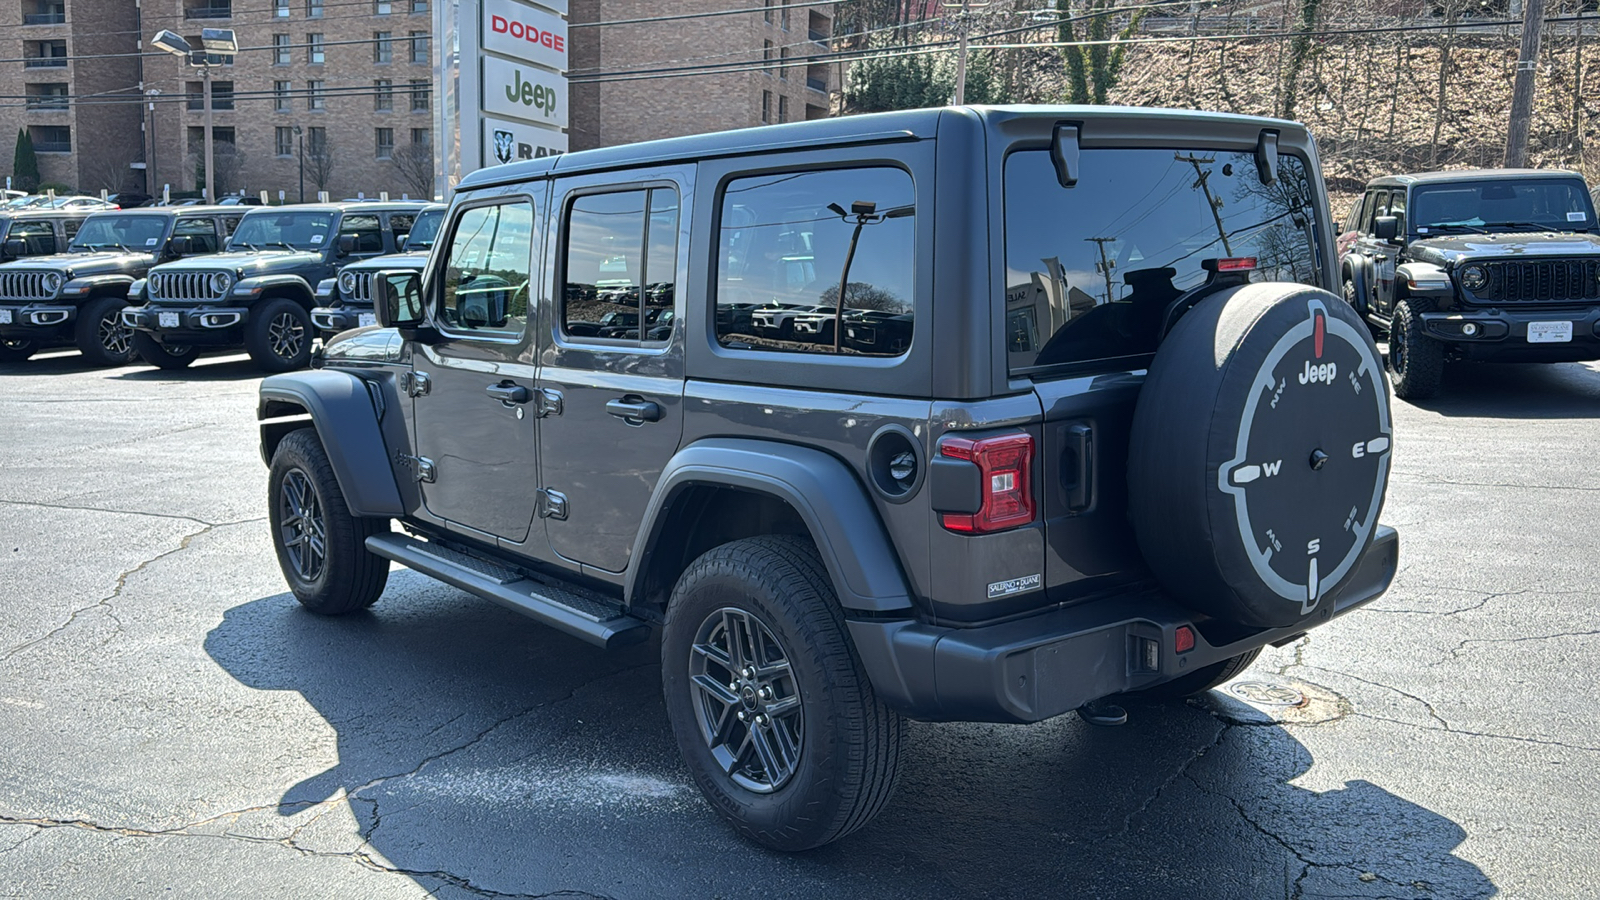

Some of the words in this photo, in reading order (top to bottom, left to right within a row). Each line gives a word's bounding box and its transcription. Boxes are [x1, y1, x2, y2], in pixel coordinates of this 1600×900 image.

[491, 14, 565, 53] DODGE
[505, 69, 556, 117] Jeep
[1298, 360, 1337, 386] Jeep
[1348, 370, 1362, 396] NE
[1269, 376, 1287, 410] NW
[1352, 441, 1365, 459] E
[1262, 458, 1283, 478] W
[1307, 537, 1321, 555] S
[989, 581, 1016, 592] SALERNO
[1020, 575, 1039, 586] DUANE
